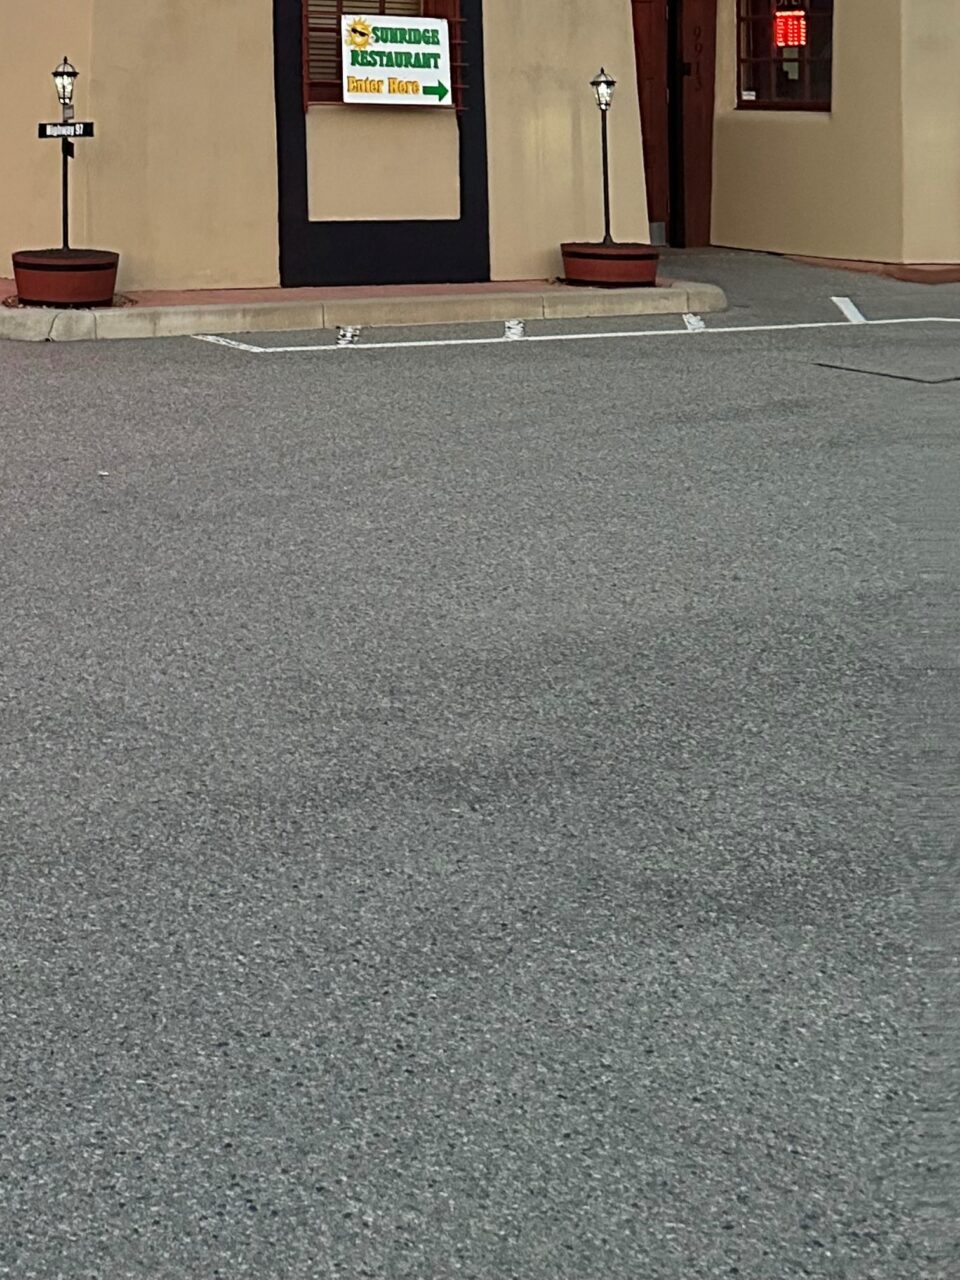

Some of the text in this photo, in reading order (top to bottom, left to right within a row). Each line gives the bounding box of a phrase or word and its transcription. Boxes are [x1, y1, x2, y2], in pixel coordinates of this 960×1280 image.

[372, 26, 440, 45] SUNRIDGE
[351, 49, 441, 69] RESTAURANT
[347, 75, 420, 94] Enter Here
